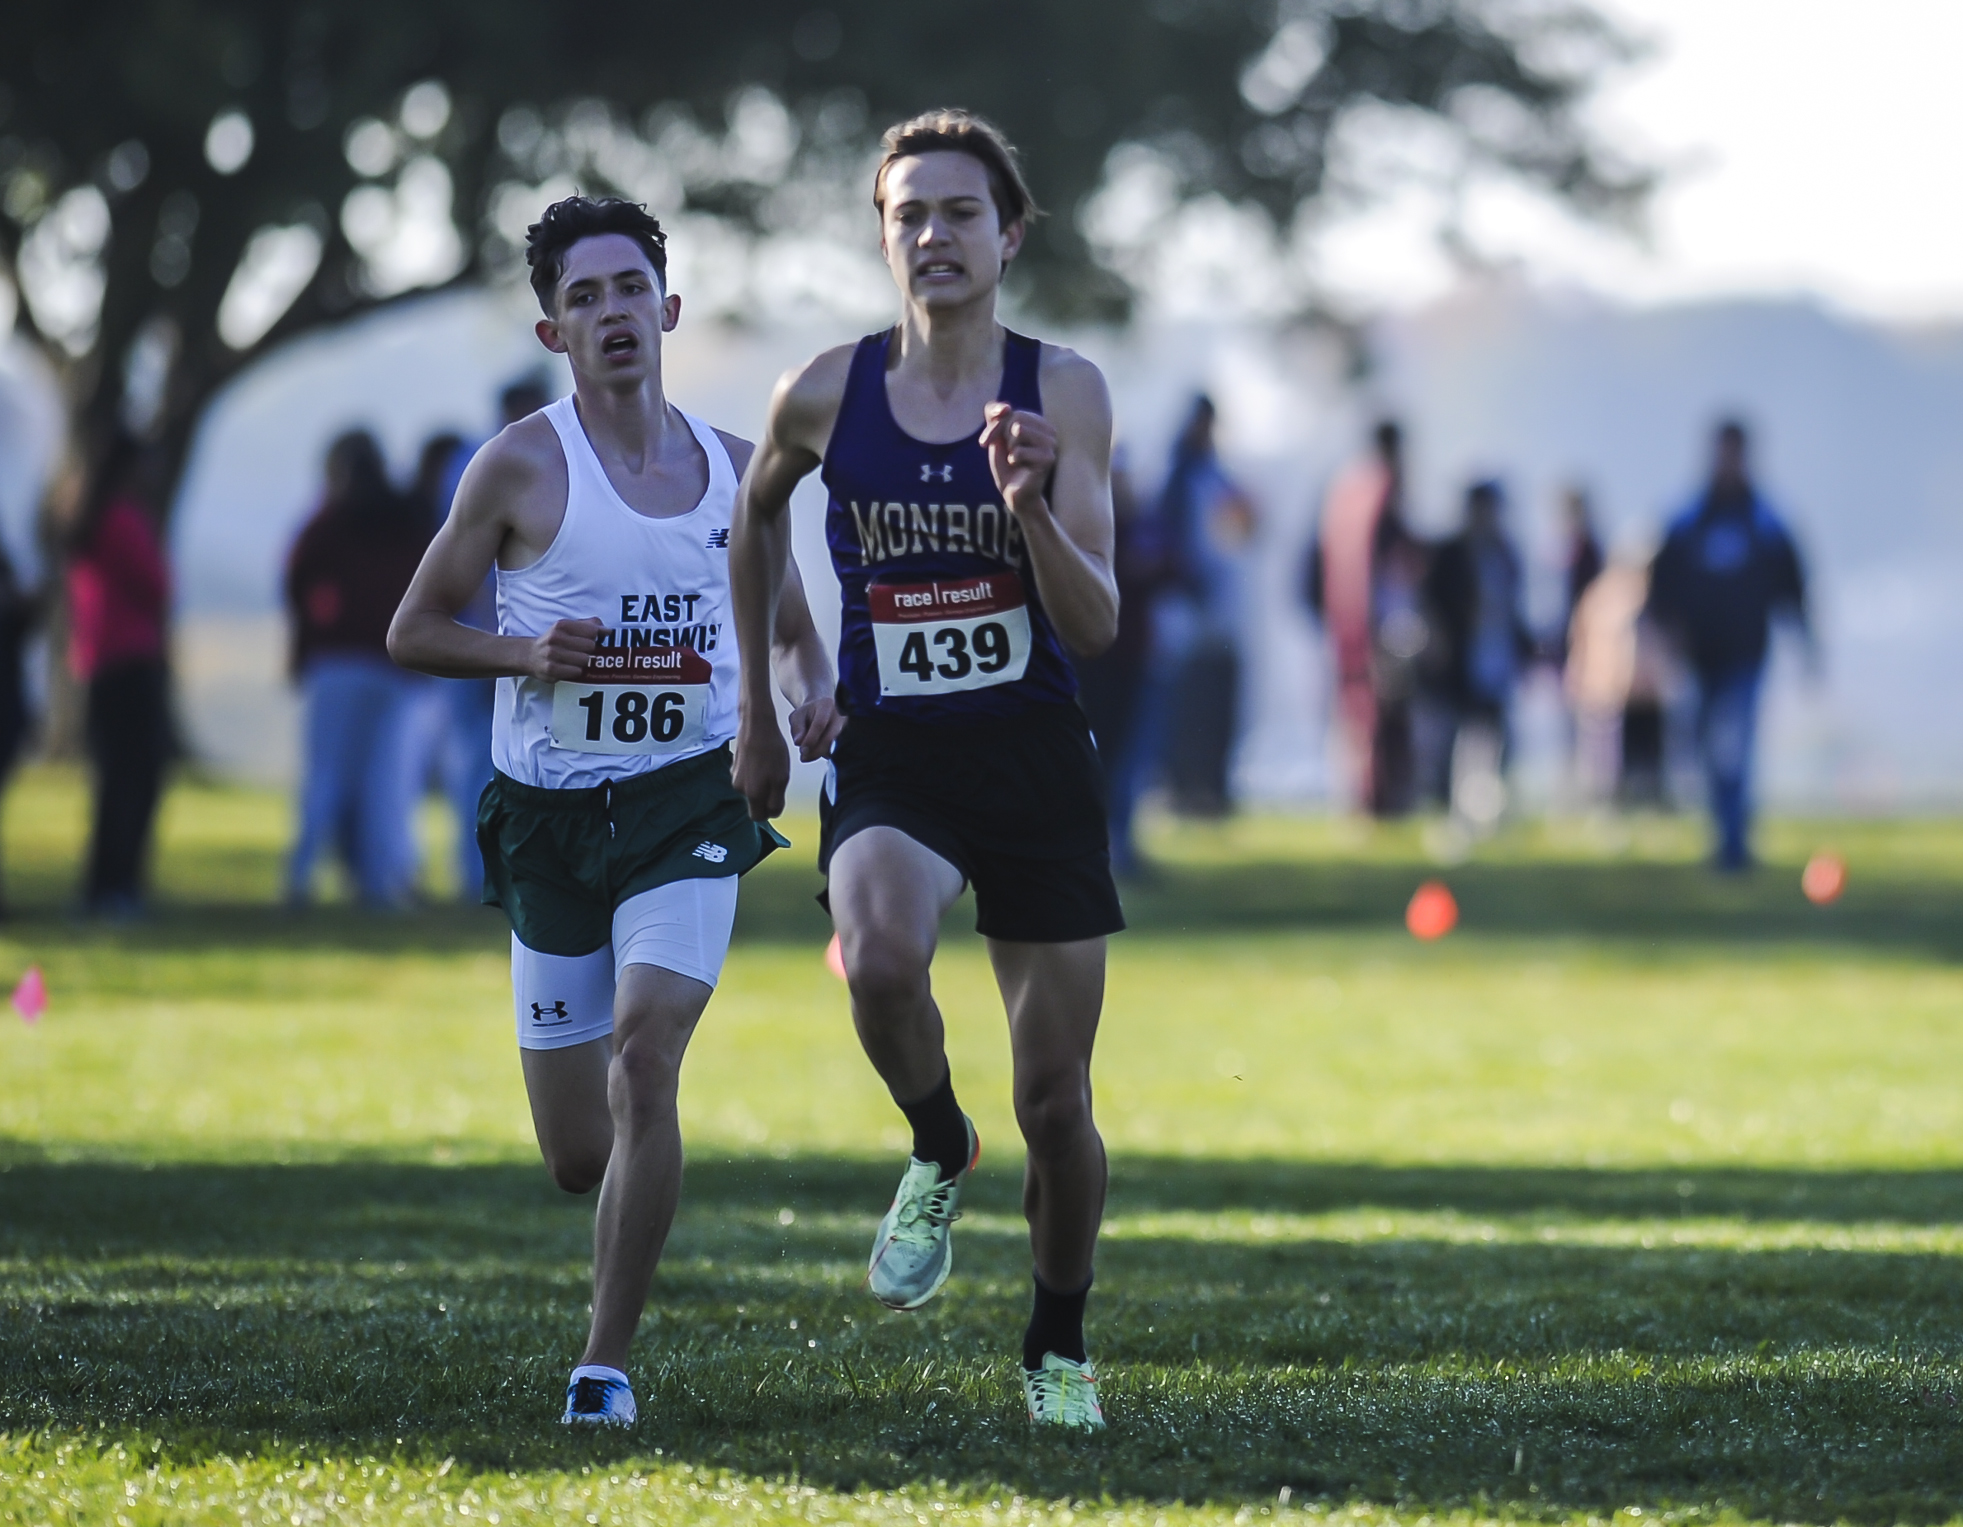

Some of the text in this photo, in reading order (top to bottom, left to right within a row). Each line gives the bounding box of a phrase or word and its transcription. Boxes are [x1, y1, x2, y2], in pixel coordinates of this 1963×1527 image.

[620, 594, 701, 622] EAST
[894, 582, 993, 607] race result
[587, 651, 682, 669] race result
[898, 622, 1011, 682] 439
[578, 691, 686, 743] 186
